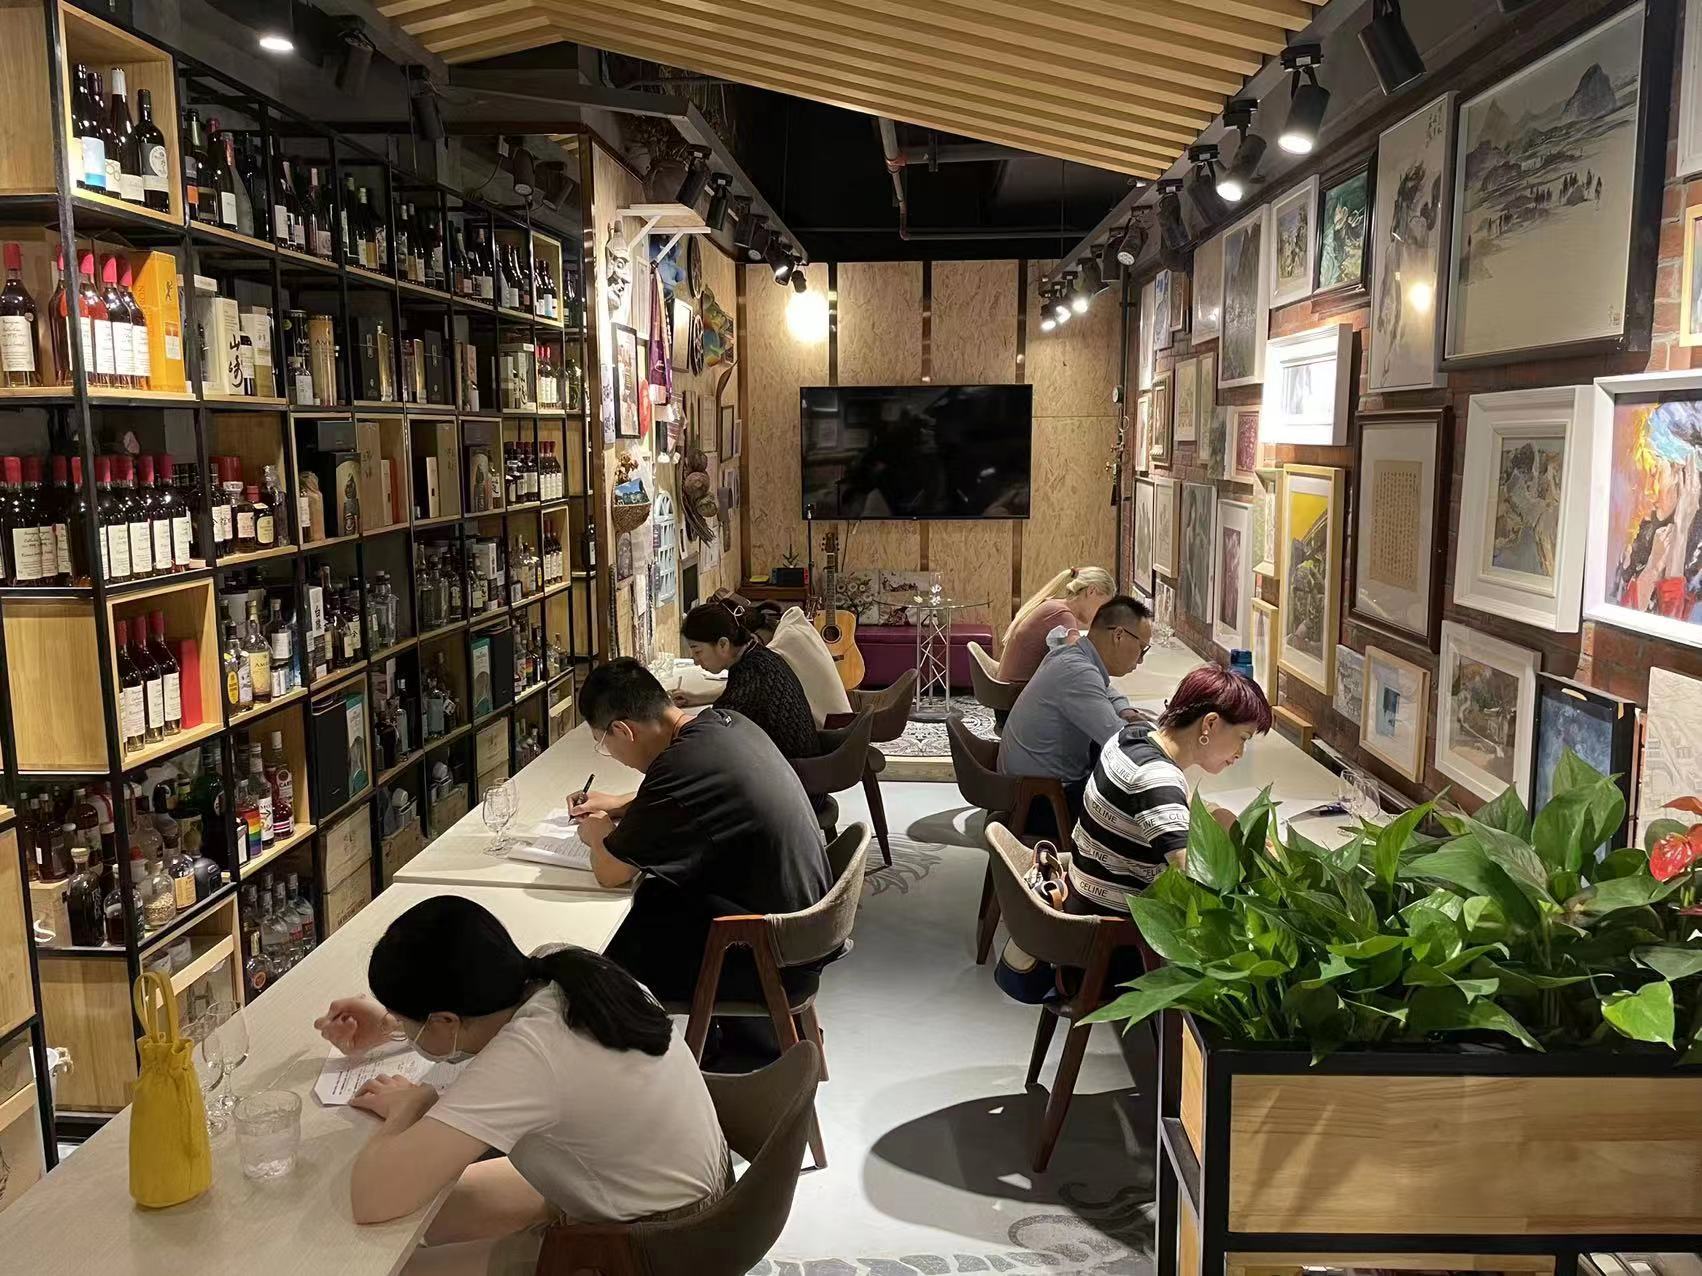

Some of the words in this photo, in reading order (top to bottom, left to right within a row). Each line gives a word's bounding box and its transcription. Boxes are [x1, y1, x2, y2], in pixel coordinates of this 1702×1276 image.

[1091, 801, 1117, 824] CELINE
[1168, 812, 1188, 822] CEL
[1080, 880, 1109, 898] CELINE
